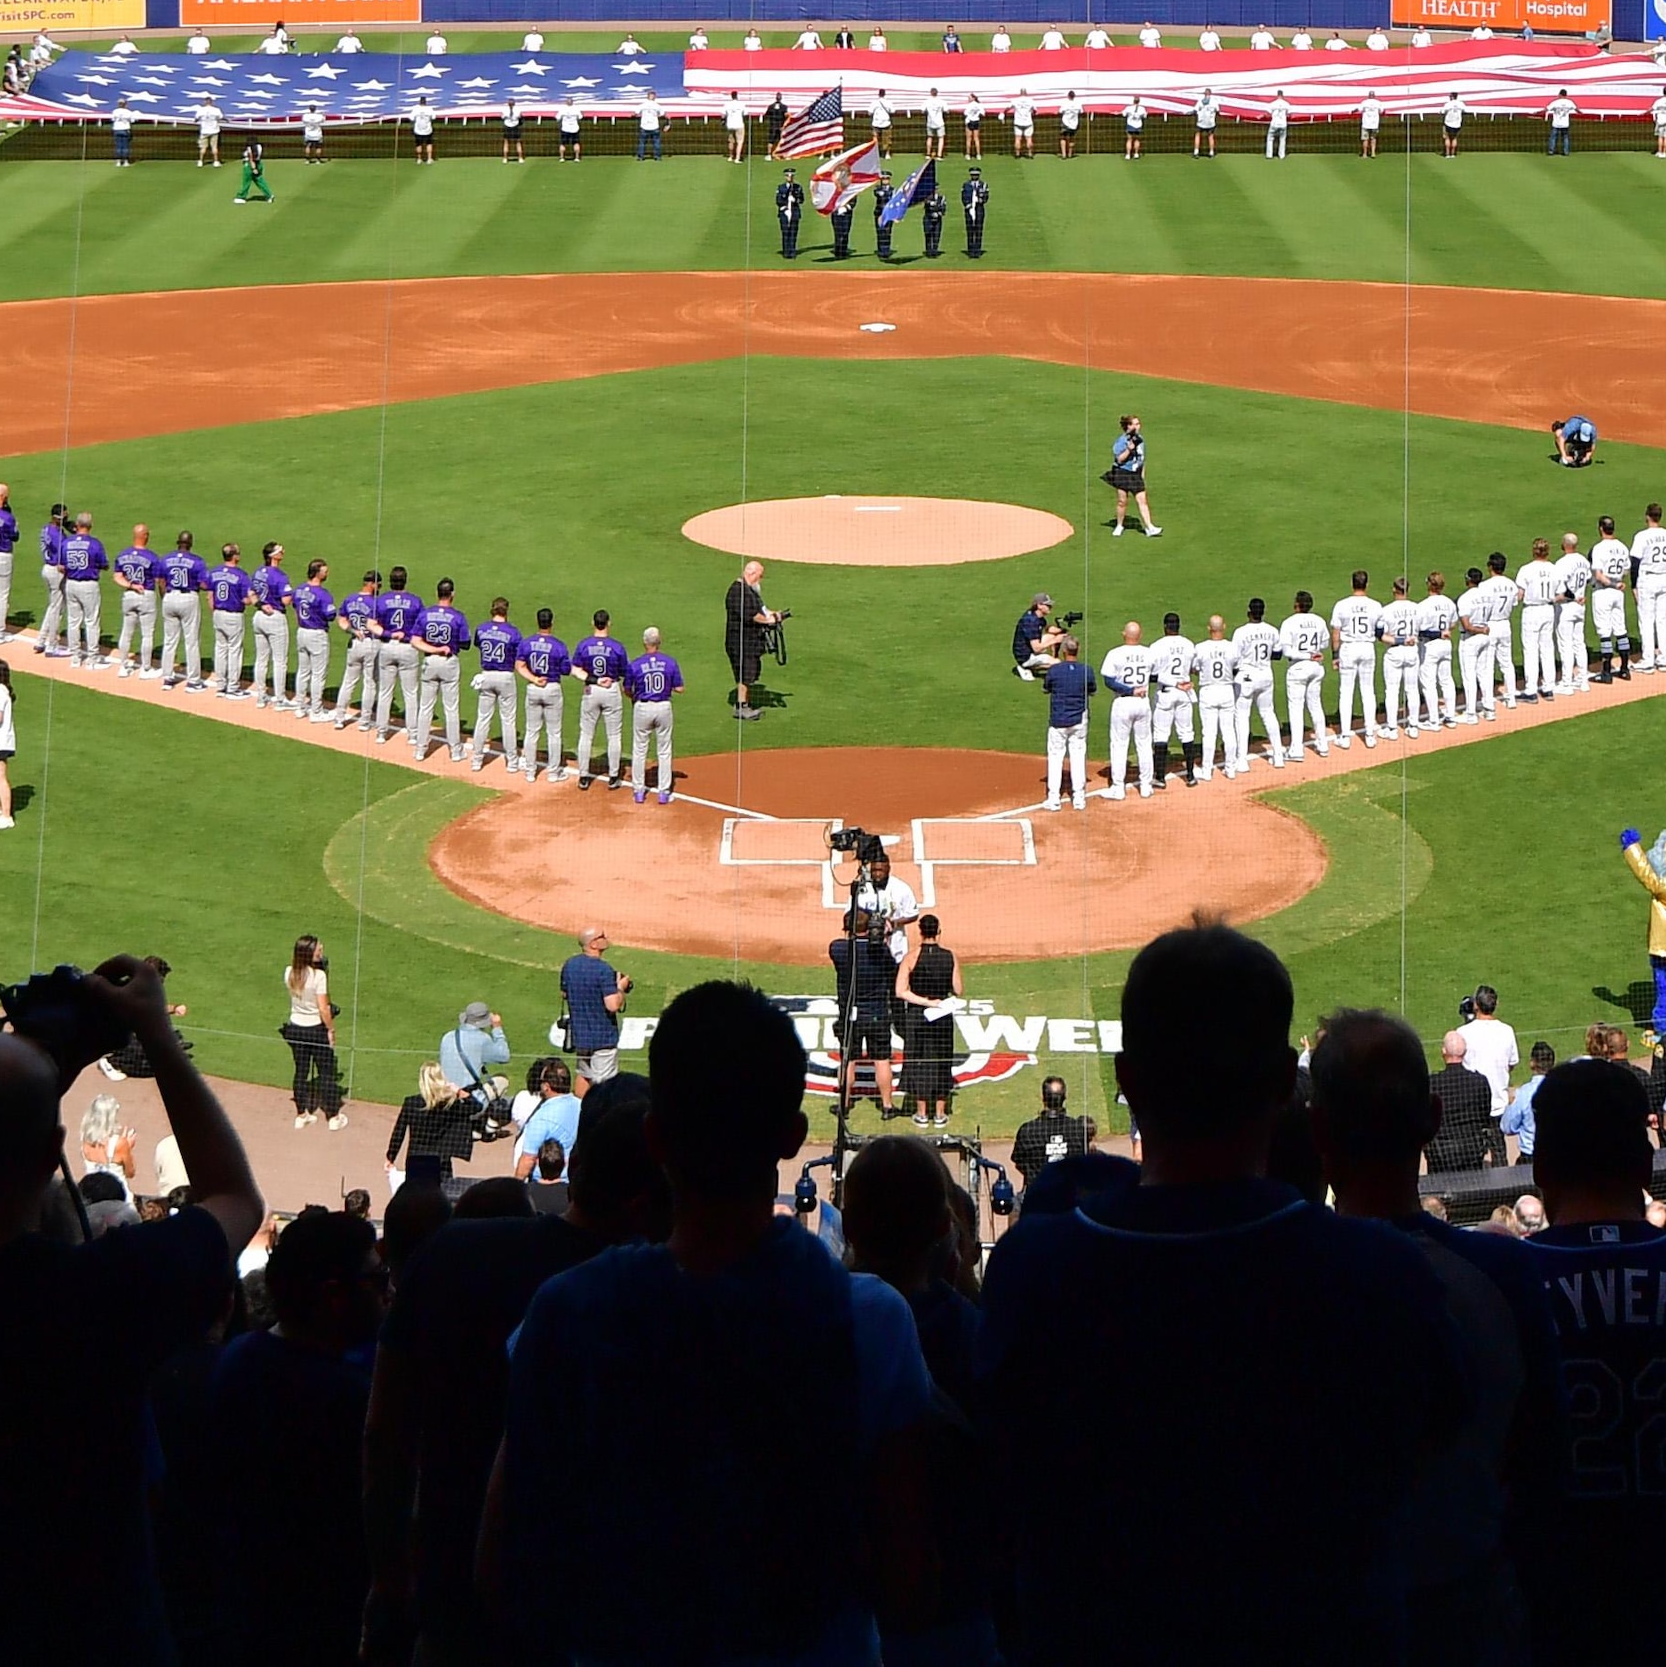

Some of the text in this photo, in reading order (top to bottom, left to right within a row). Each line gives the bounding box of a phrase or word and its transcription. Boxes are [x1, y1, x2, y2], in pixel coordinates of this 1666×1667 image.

[1526, 1, 1588, 19] Hospital
[66, 548, 89, 570] 53
[1607, 557, 1624, 575] 26
[170, 567, 189, 588] 31
[216, 580, 230, 602] 8
[1540, 581, 1551, 599] 11
[1499, 595, 1508, 613] 7
[390, 608, 404, 630] 4
[1351, 616, 1369, 634] 15
[1397, 619, 1414, 637] 21
[1438, 614, 1447, 631] 6
[425, 622, 452, 645] 23
[1298, 632, 1319, 652] 24
[482, 642, 506, 664] 24
[1254, 642, 1269, 662] 13
[528, 652, 550, 675] 14
[592, 655, 608, 677] 9
[1170, 657, 1182, 676] 2
[1212, 660, 1224, 680] 8
[643, 671, 665, 694] 10
[1123, 665, 1146, 685] 25
